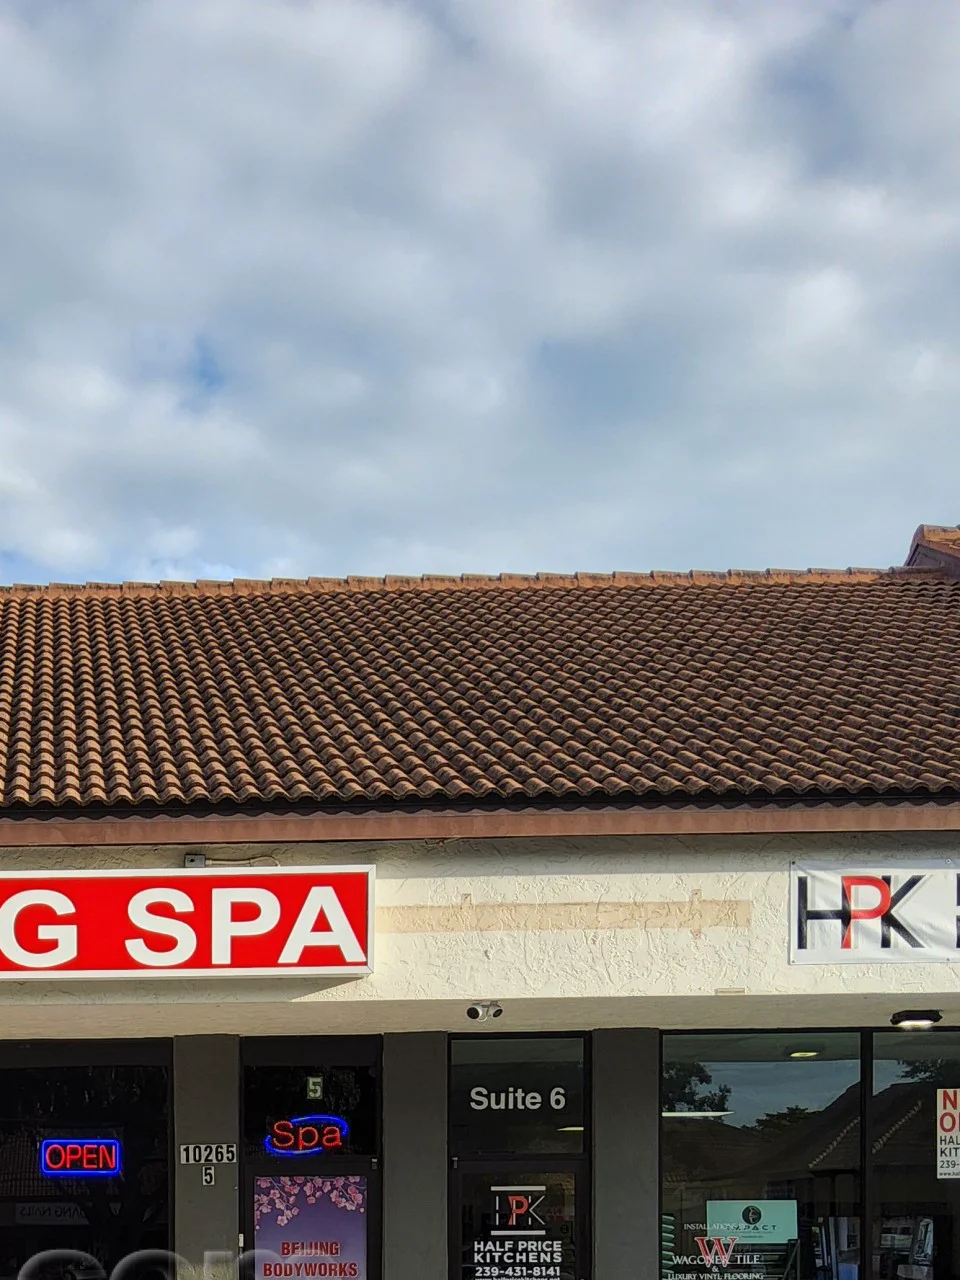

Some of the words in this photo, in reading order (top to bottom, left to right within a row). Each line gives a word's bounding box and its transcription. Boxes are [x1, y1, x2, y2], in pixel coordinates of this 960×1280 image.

[797, 874, 927, 950] HPK
[124, 886, 367, 967] SPA
[309, 1078, 321, 1098] 5
[470, 1087, 542, 1110] Suite
[550, 1087, 566, 1110] 6
[939, 1112, 960, 1133] O
[272, 1120, 343, 1152] Spa
[46, 1144, 116, 1169] OPEN
[183, 1145, 235, 1163] 10265
[204, 1167, 213, 1184] 5
[281, 1241, 340, 1257] BEIJING
[474, 1241, 514, 1252] HALF
[518, 1240, 562, 1252] PRICE
[474, 1252, 562, 1263] KITCHENS
[734, 1255, 761, 1265] TILE
[263, 1262, 358, 1278] BODYWORKS
[475, 1266, 561, 1277] 239-431-8141
[667, 1273, 698, 1280] LUXURY
[711, 1265, 720, 1273] &
